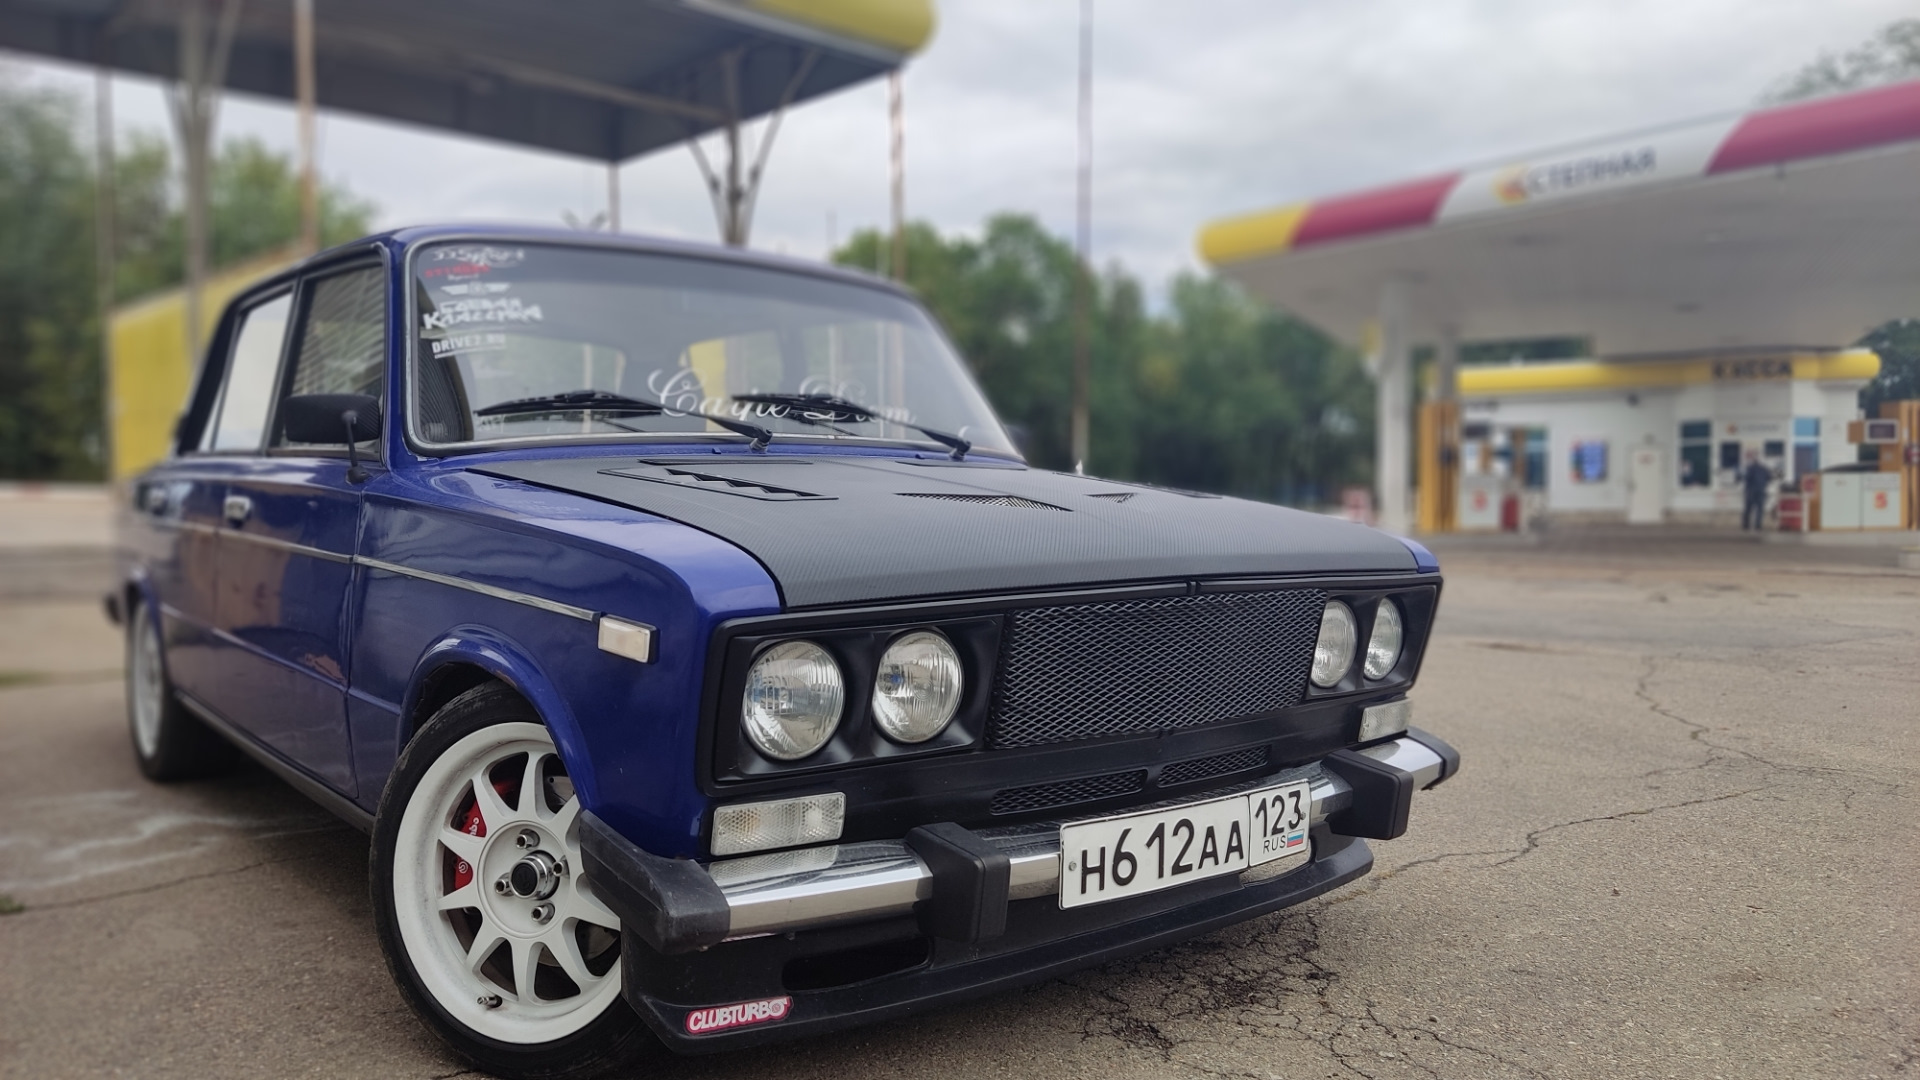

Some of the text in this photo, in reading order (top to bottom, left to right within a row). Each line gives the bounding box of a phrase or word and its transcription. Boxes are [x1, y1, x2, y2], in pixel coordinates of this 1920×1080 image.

[1080, 789, 1302, 895] Н612АА 123
[1263, 835, 1286, 854] RUS
[689, 998, 787, 1031] CLUBTURBO
